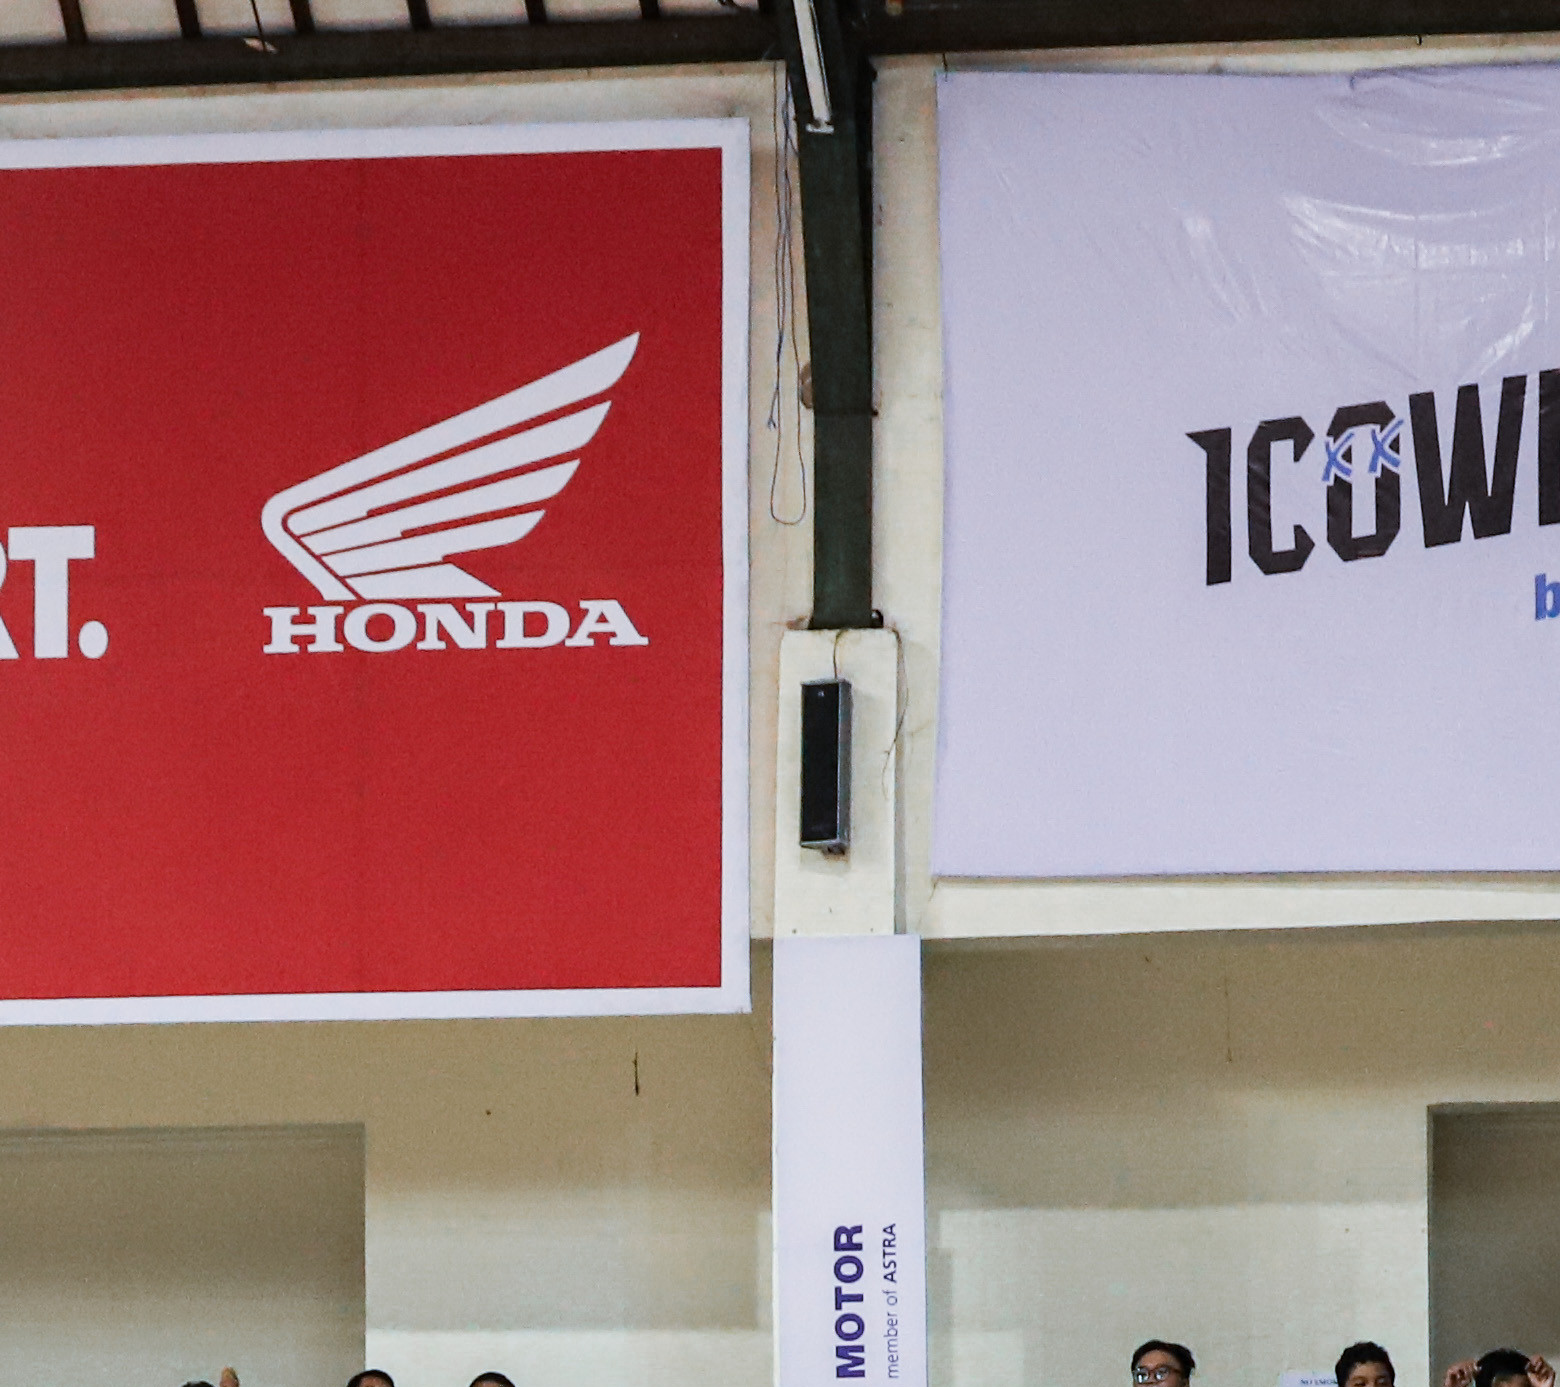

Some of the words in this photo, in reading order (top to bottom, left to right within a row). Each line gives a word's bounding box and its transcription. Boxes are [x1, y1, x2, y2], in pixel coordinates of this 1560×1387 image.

[263, 599, 649, 654] HONDA
[884, 1223, 897, 1283] ASTRA
[833, 1225, 865, 1377] MOTOR
[883, 1290, 898, 1306] of
[885, 1311, 899, 1379] member
